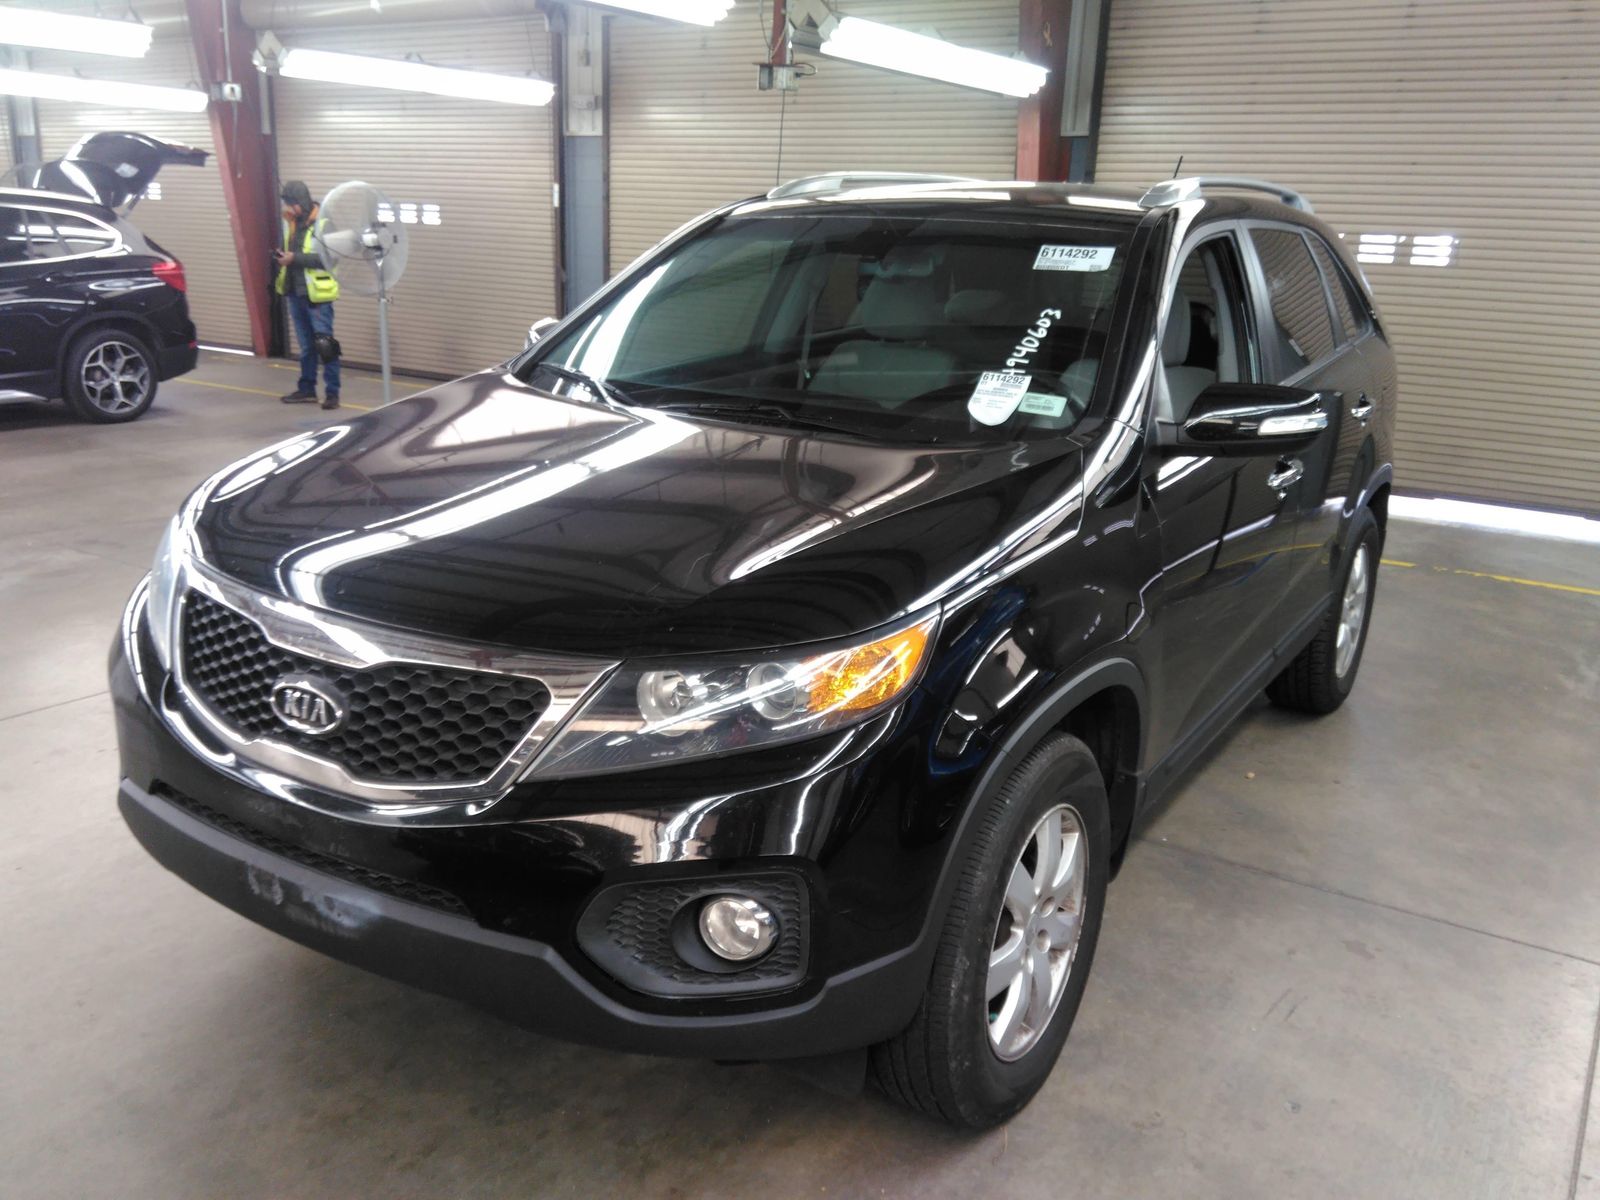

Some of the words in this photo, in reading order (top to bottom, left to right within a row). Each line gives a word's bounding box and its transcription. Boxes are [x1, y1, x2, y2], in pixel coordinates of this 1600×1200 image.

[1041, 247, 1098, 259] 6114292
[982, 373, 1026, 385] 6114292
[284, 689, 328, 725] KIA
